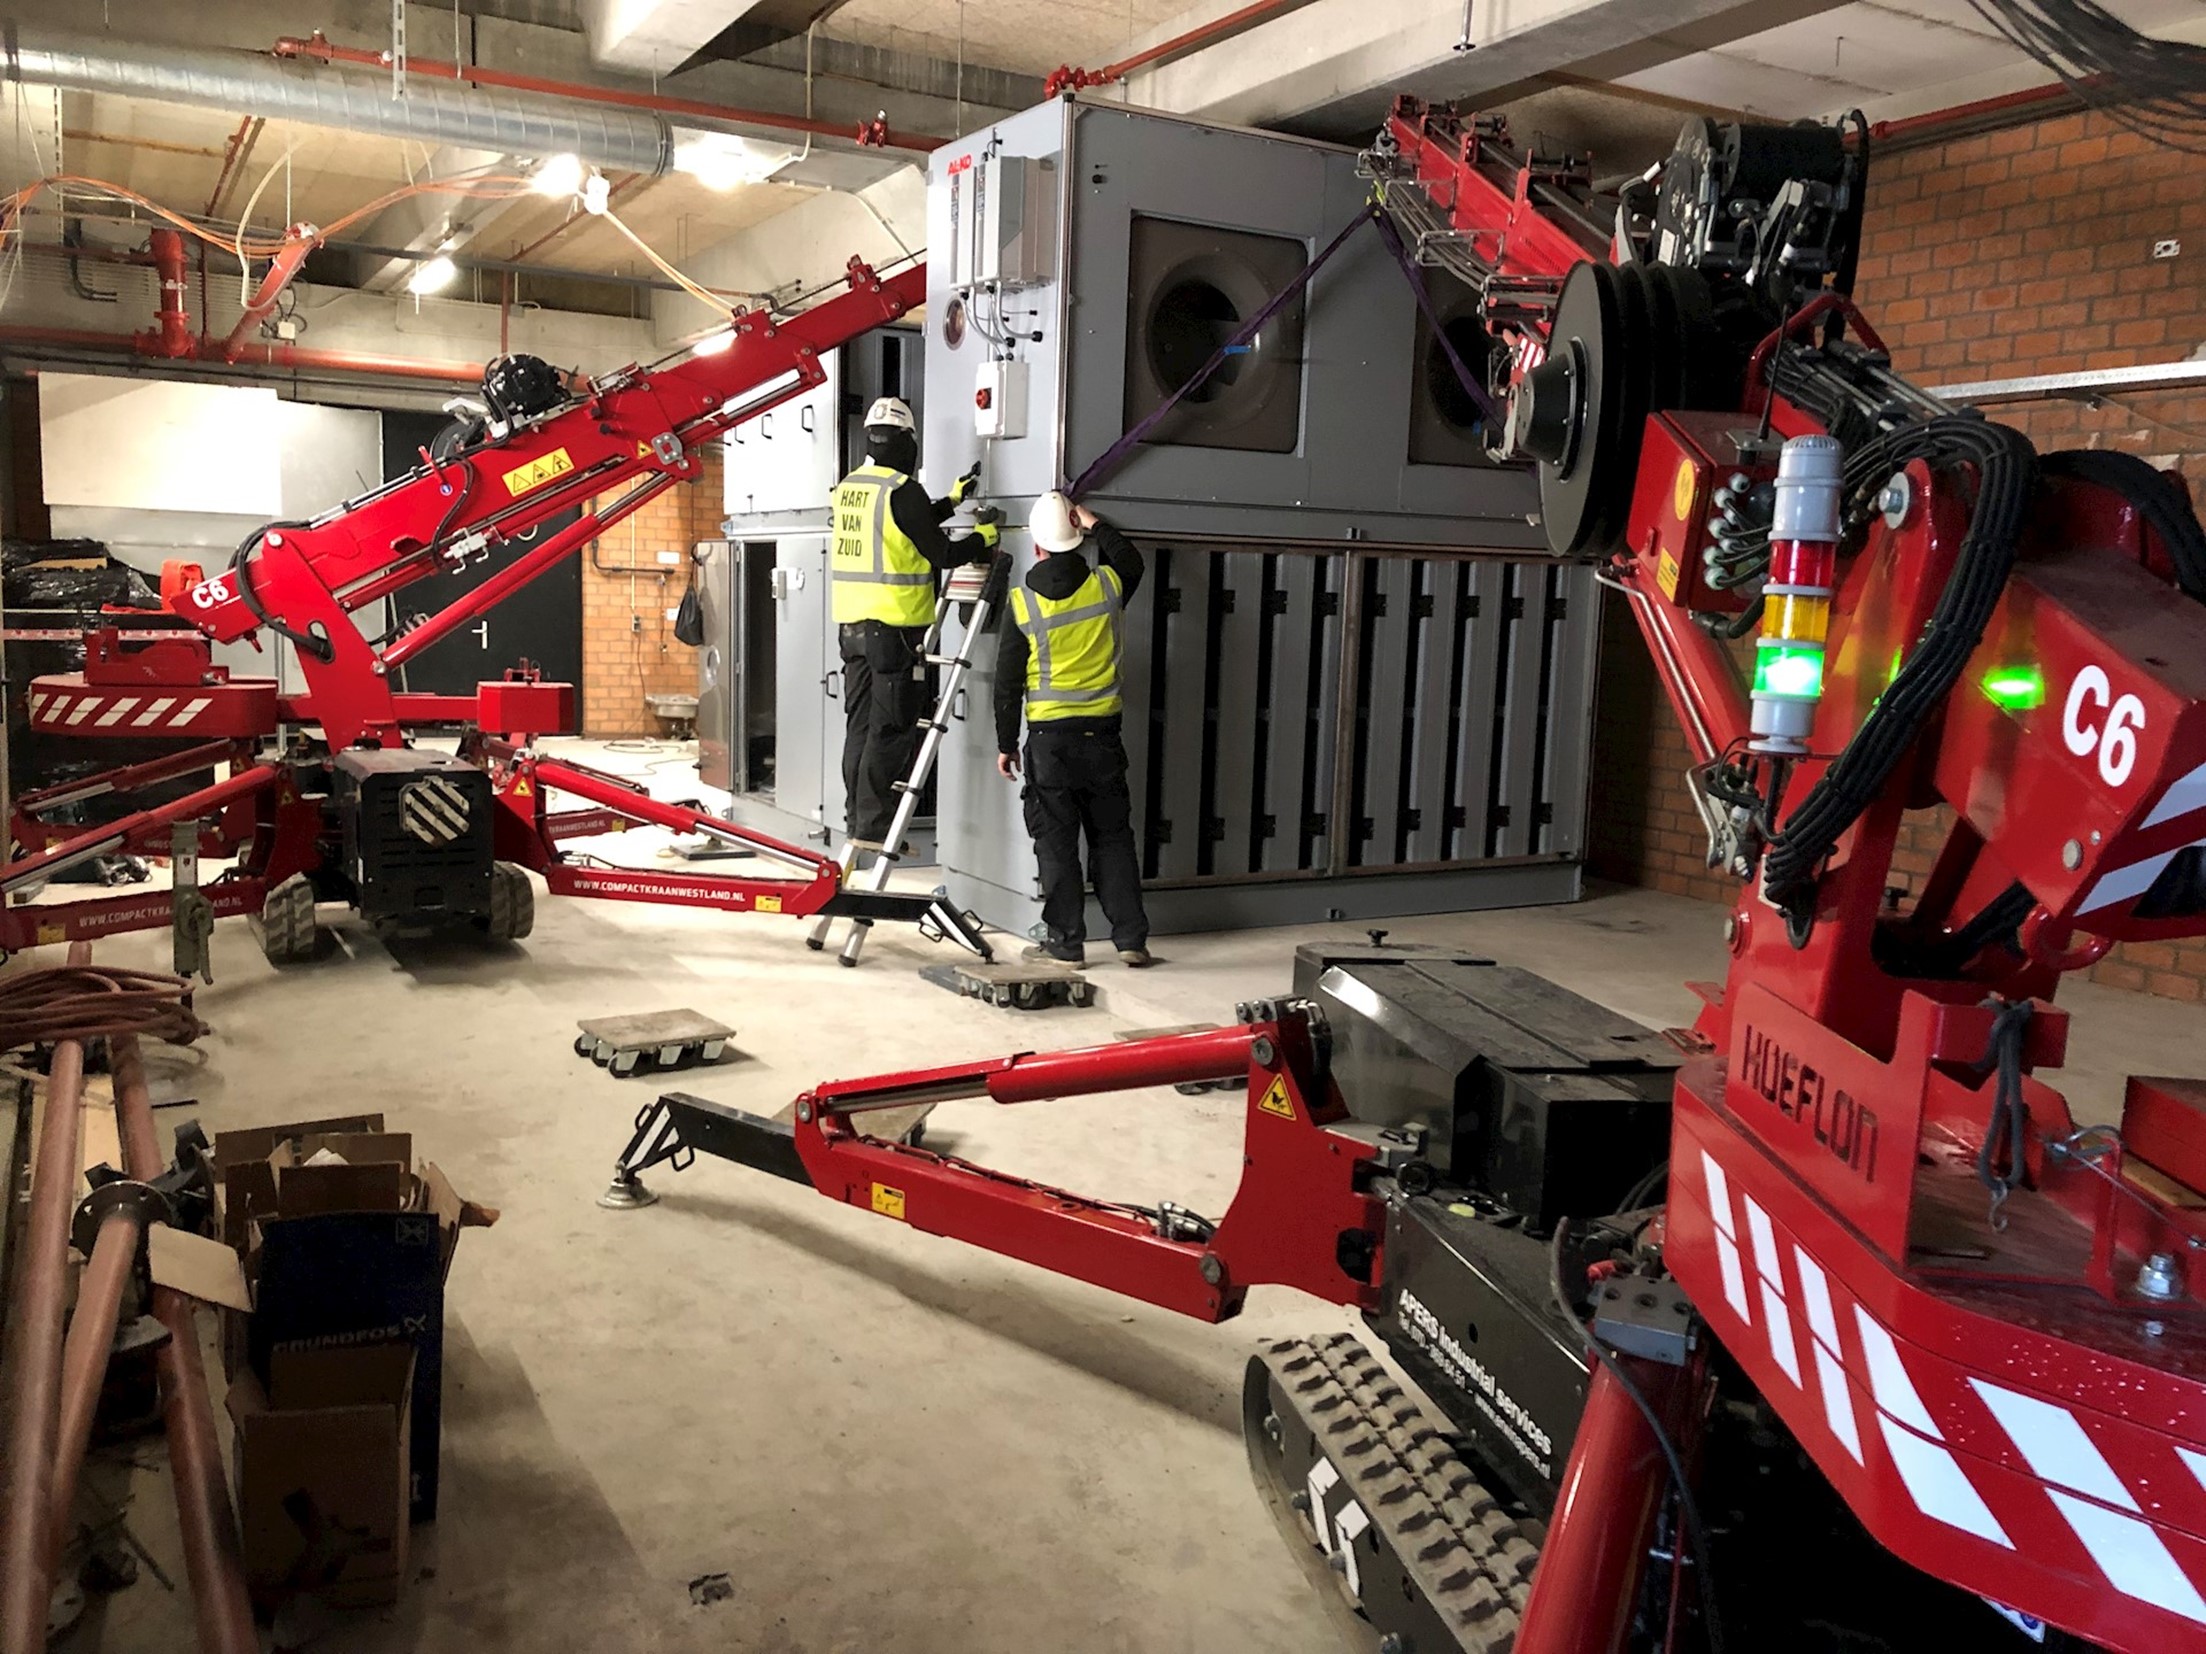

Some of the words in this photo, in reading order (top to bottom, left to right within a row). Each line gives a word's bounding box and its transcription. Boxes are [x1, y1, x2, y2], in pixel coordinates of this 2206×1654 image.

[840, 490, 870, 508] HART
[842, 514, 862, 532] VAN
[837, 538, 863, 557] ZUID
[192, 579, 229, 609] C6
[2063, 664, 2146, 787] C6
[574, 879, 746, 902] WWW.COMPACTKRAANWESTLAND.NL
[1398, 1288, 1439, 1339] APERS
[1439, 1325, 1496, 1397] Industrial
[1495, 1388, 1552, 1455] services
